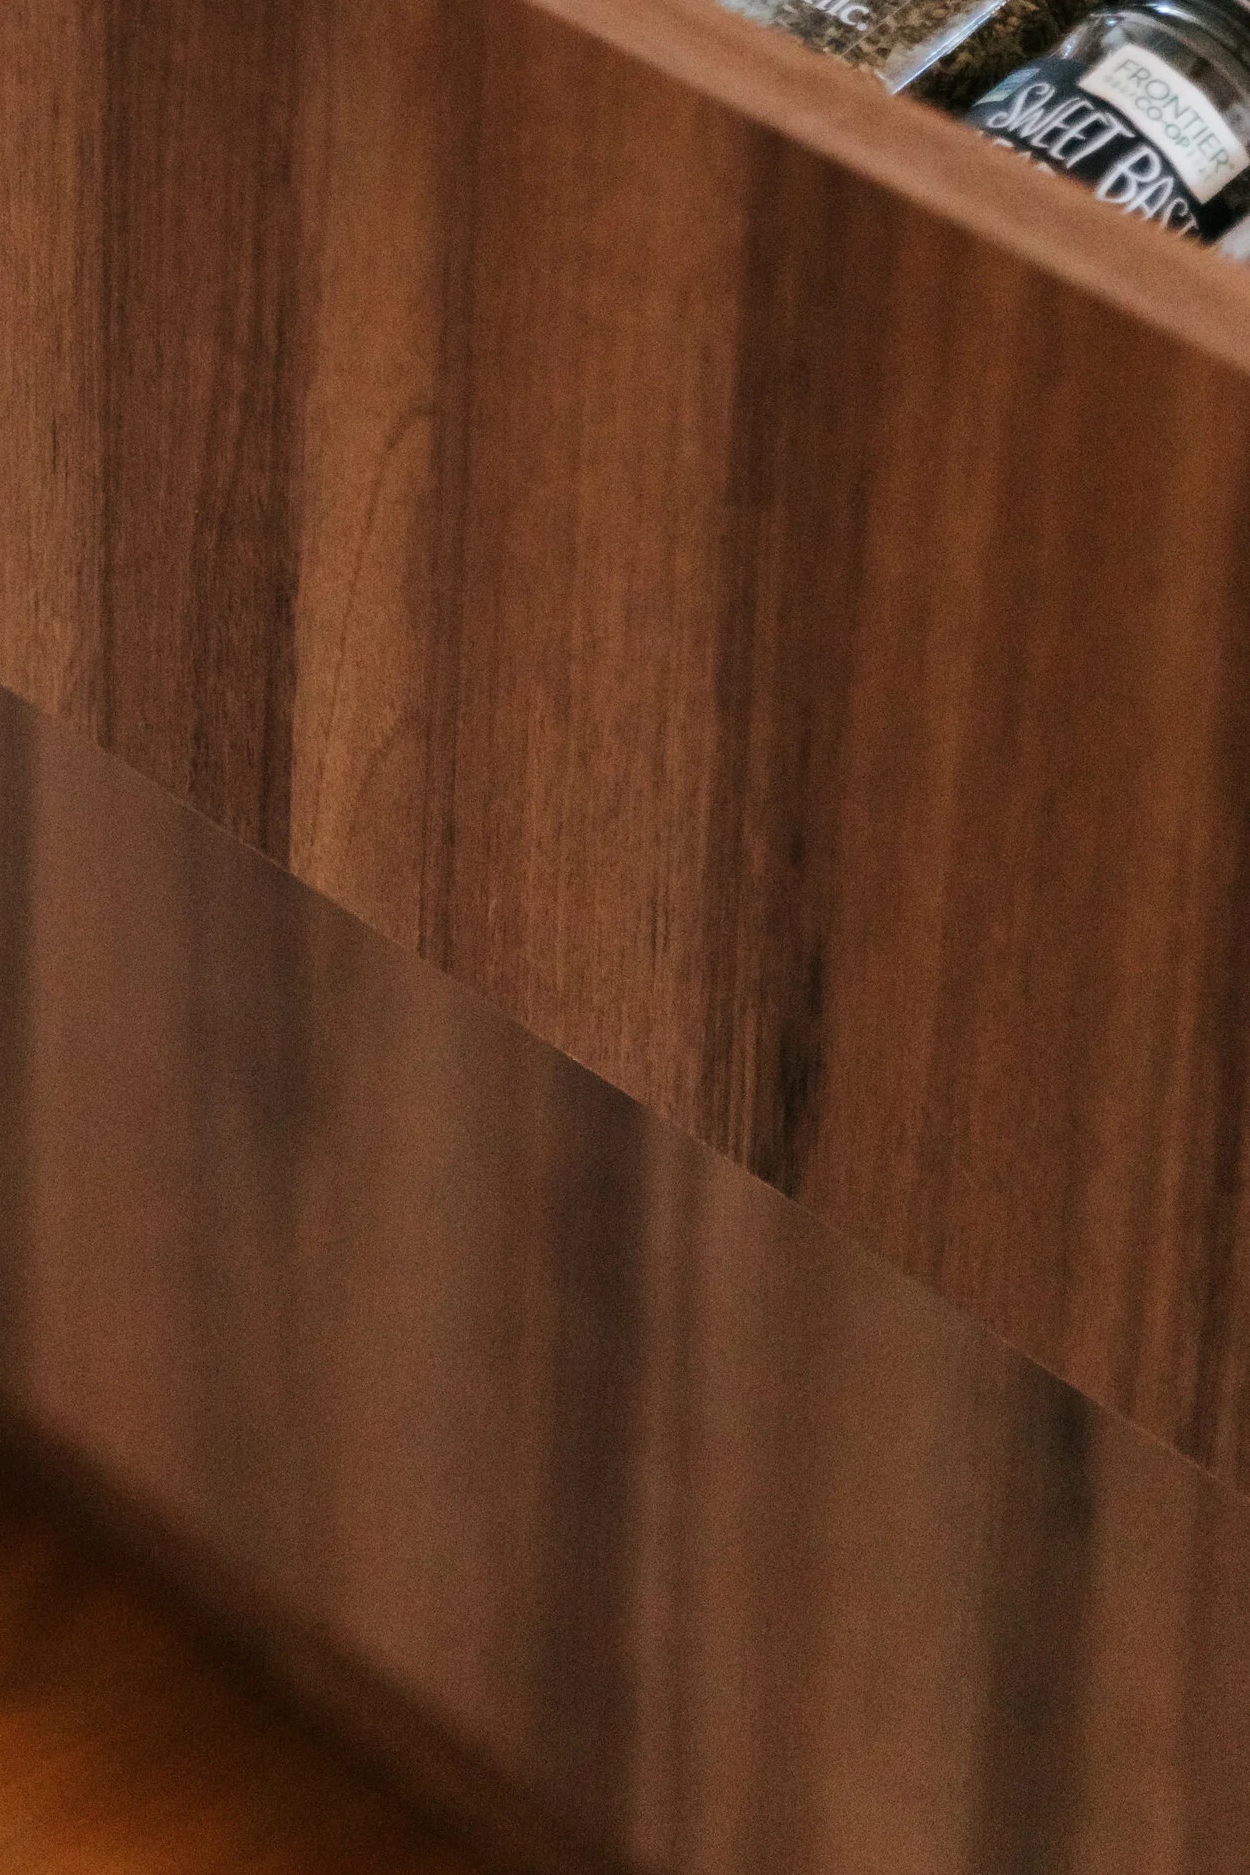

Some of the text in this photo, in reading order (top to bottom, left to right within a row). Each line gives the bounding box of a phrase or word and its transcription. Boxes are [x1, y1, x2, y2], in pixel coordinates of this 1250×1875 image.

[986, 82, 1136, 168] SWEET
[1113, 59, 1230, 173] FRONTIER
[1134, 93, 1190, 150] CO-OP
